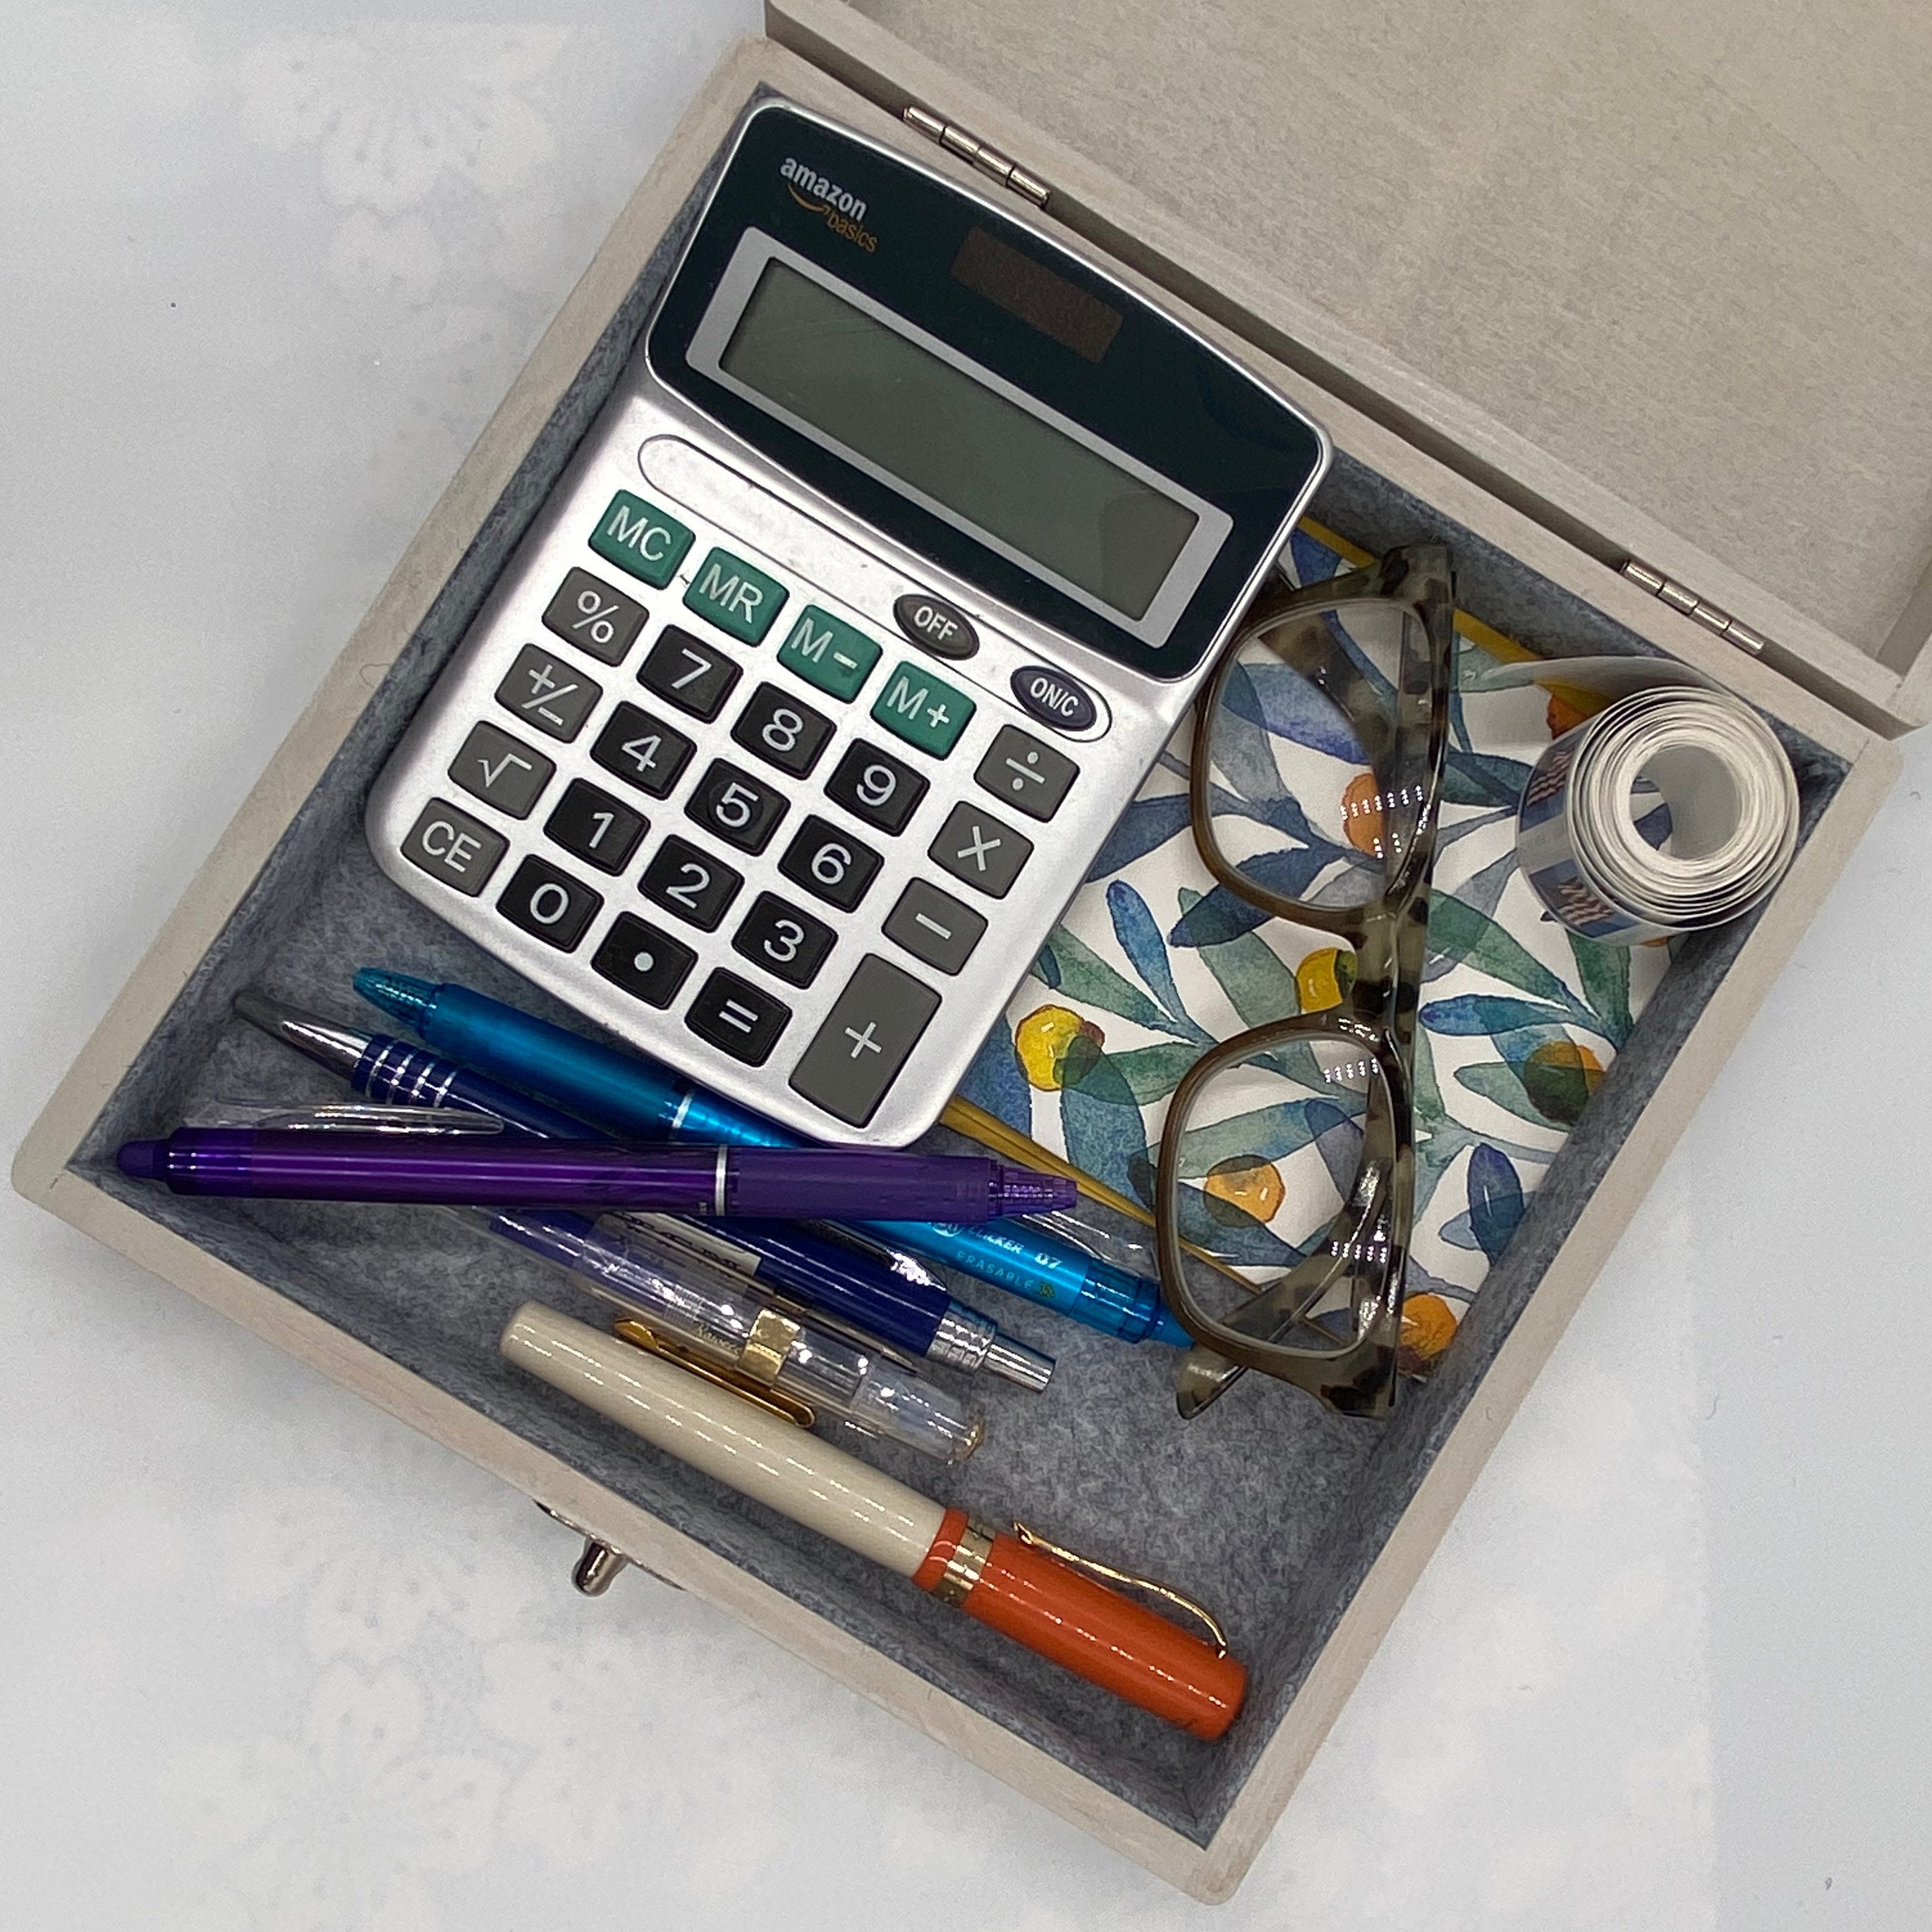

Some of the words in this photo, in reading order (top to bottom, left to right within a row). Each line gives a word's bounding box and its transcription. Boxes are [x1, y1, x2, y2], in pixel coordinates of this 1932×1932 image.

[780, 157, 867, 221] amazon
[827, 211, 878, 253] basics
[607, 505, 672, 561] MC
[698, 564, 765, 624] MR
[913, 606, 958, 641] OFF
[671, 648, 712, 689] 7
[1030, 677, 1079, 717] ON/C
[761, 708, 803, 752] 8
[621, 735, 662, 772] 4
[716, 782, 759, 827] 5
[856, 765, 896, 806] 9
[423, 820, 481, 873] CE
[589, 812, 614, 849] 1
[811, 843, 851, 885] 6
[530, 883, 569, 924] 0
[666, 863, 711, 910] 2
[764, 919, 804, 961] 3
[956, 1250, 1033, 1289] ERASABLE
